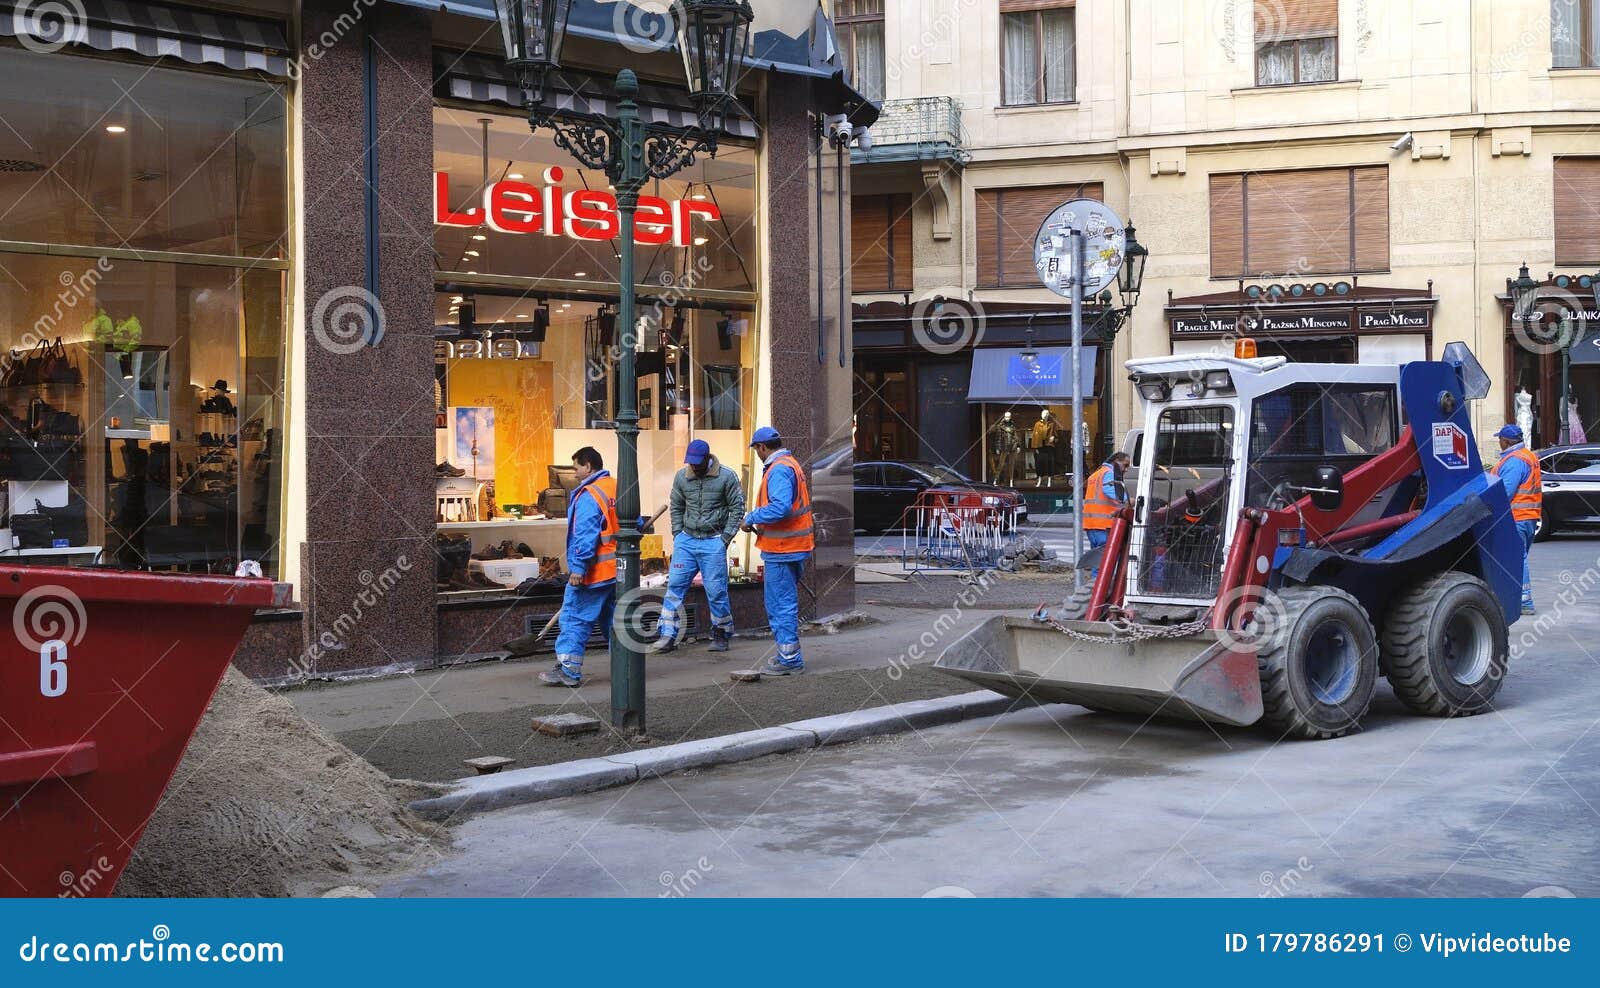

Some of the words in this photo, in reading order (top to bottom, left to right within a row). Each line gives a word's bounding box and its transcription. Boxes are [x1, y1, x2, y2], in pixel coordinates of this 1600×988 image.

[433, 166, 720, 247] Leiser
[1176, 321, 1209, 332] PRAGUE
[1210, 320, 1235, 331] MINT
[1301, 317, 1347, 328] MINCOVNA
[1364, 315, 1389, 326] PRAG
[1435, 427, 1452, 437] DAP
[40, 639, 68, 697] 6
